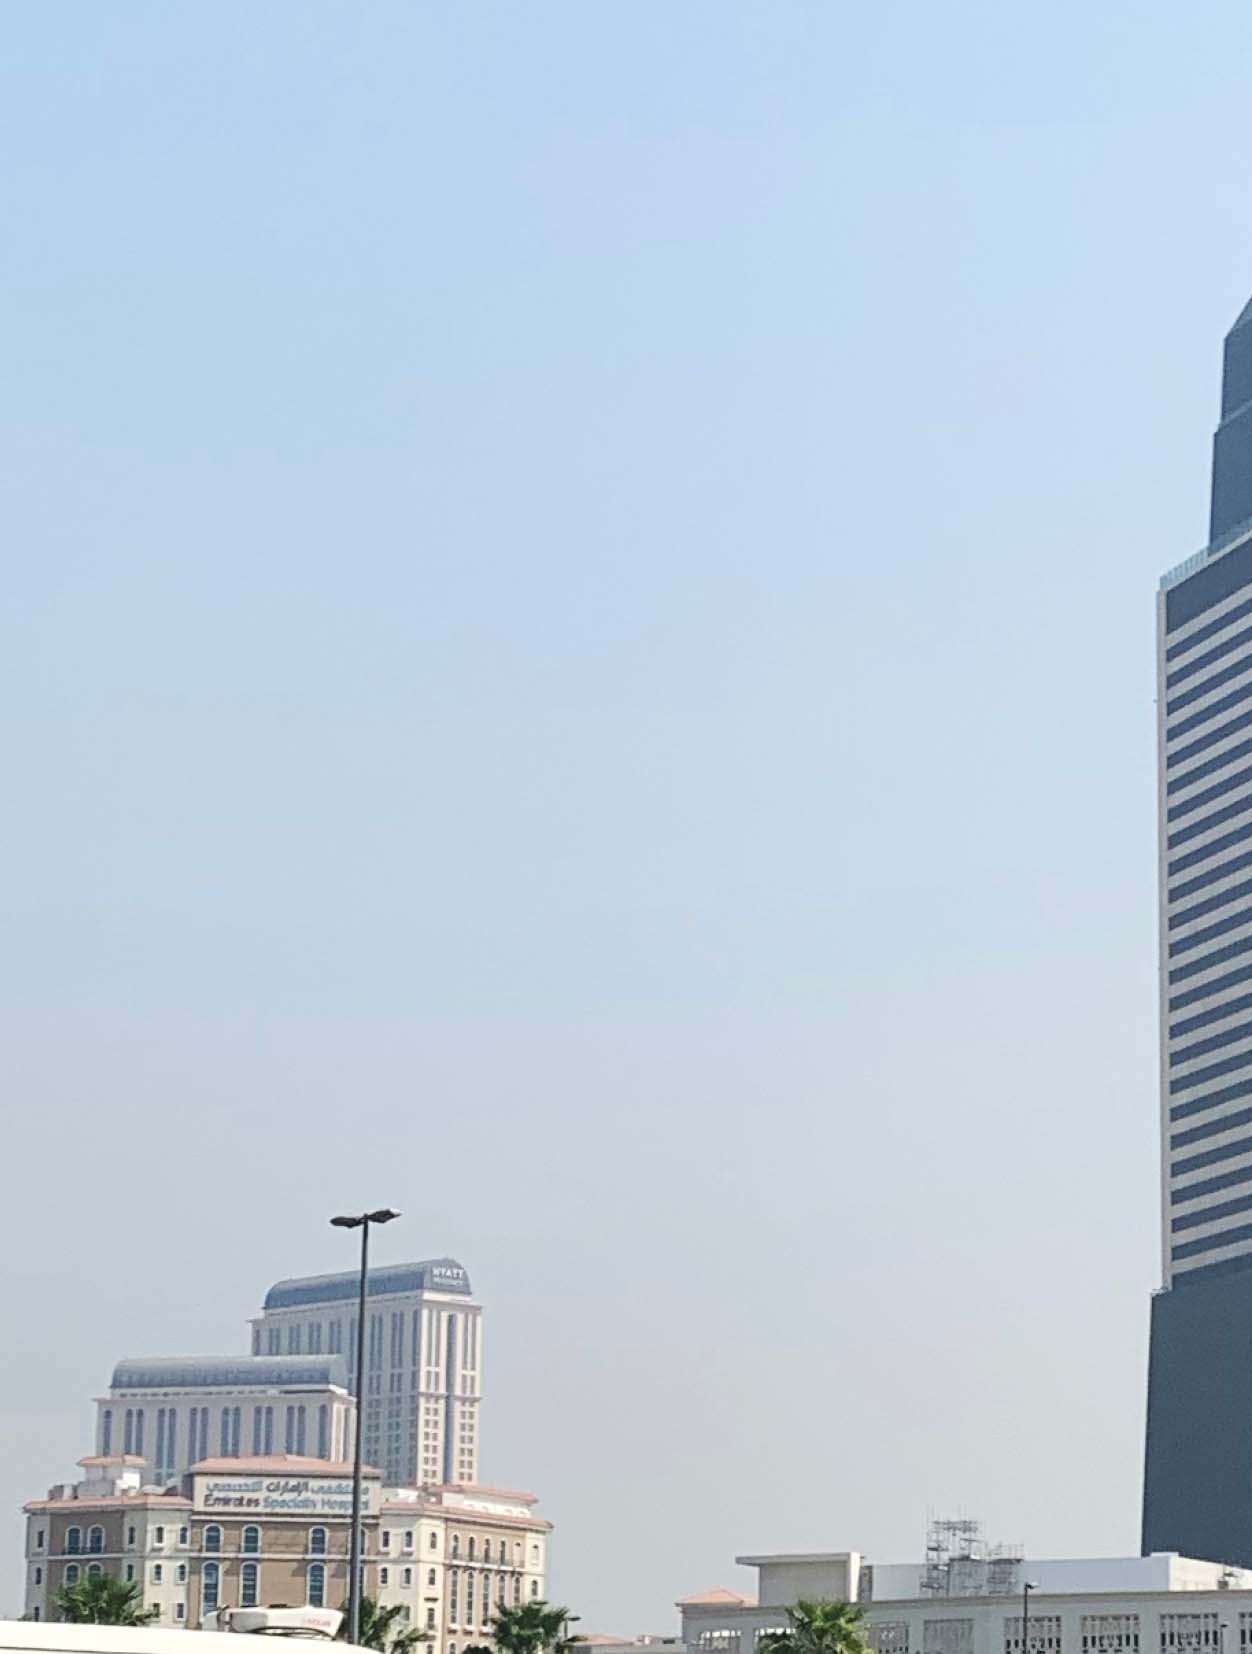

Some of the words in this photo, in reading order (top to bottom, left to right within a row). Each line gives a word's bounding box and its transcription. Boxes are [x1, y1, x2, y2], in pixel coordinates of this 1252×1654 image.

[433, 1267, 464, 1278] HYATT
[204, 1494, 260, 1507] Emirates
[263, 1496, 317, 1510] Specialty
[321, 1498, 369, 1511] Hospal
